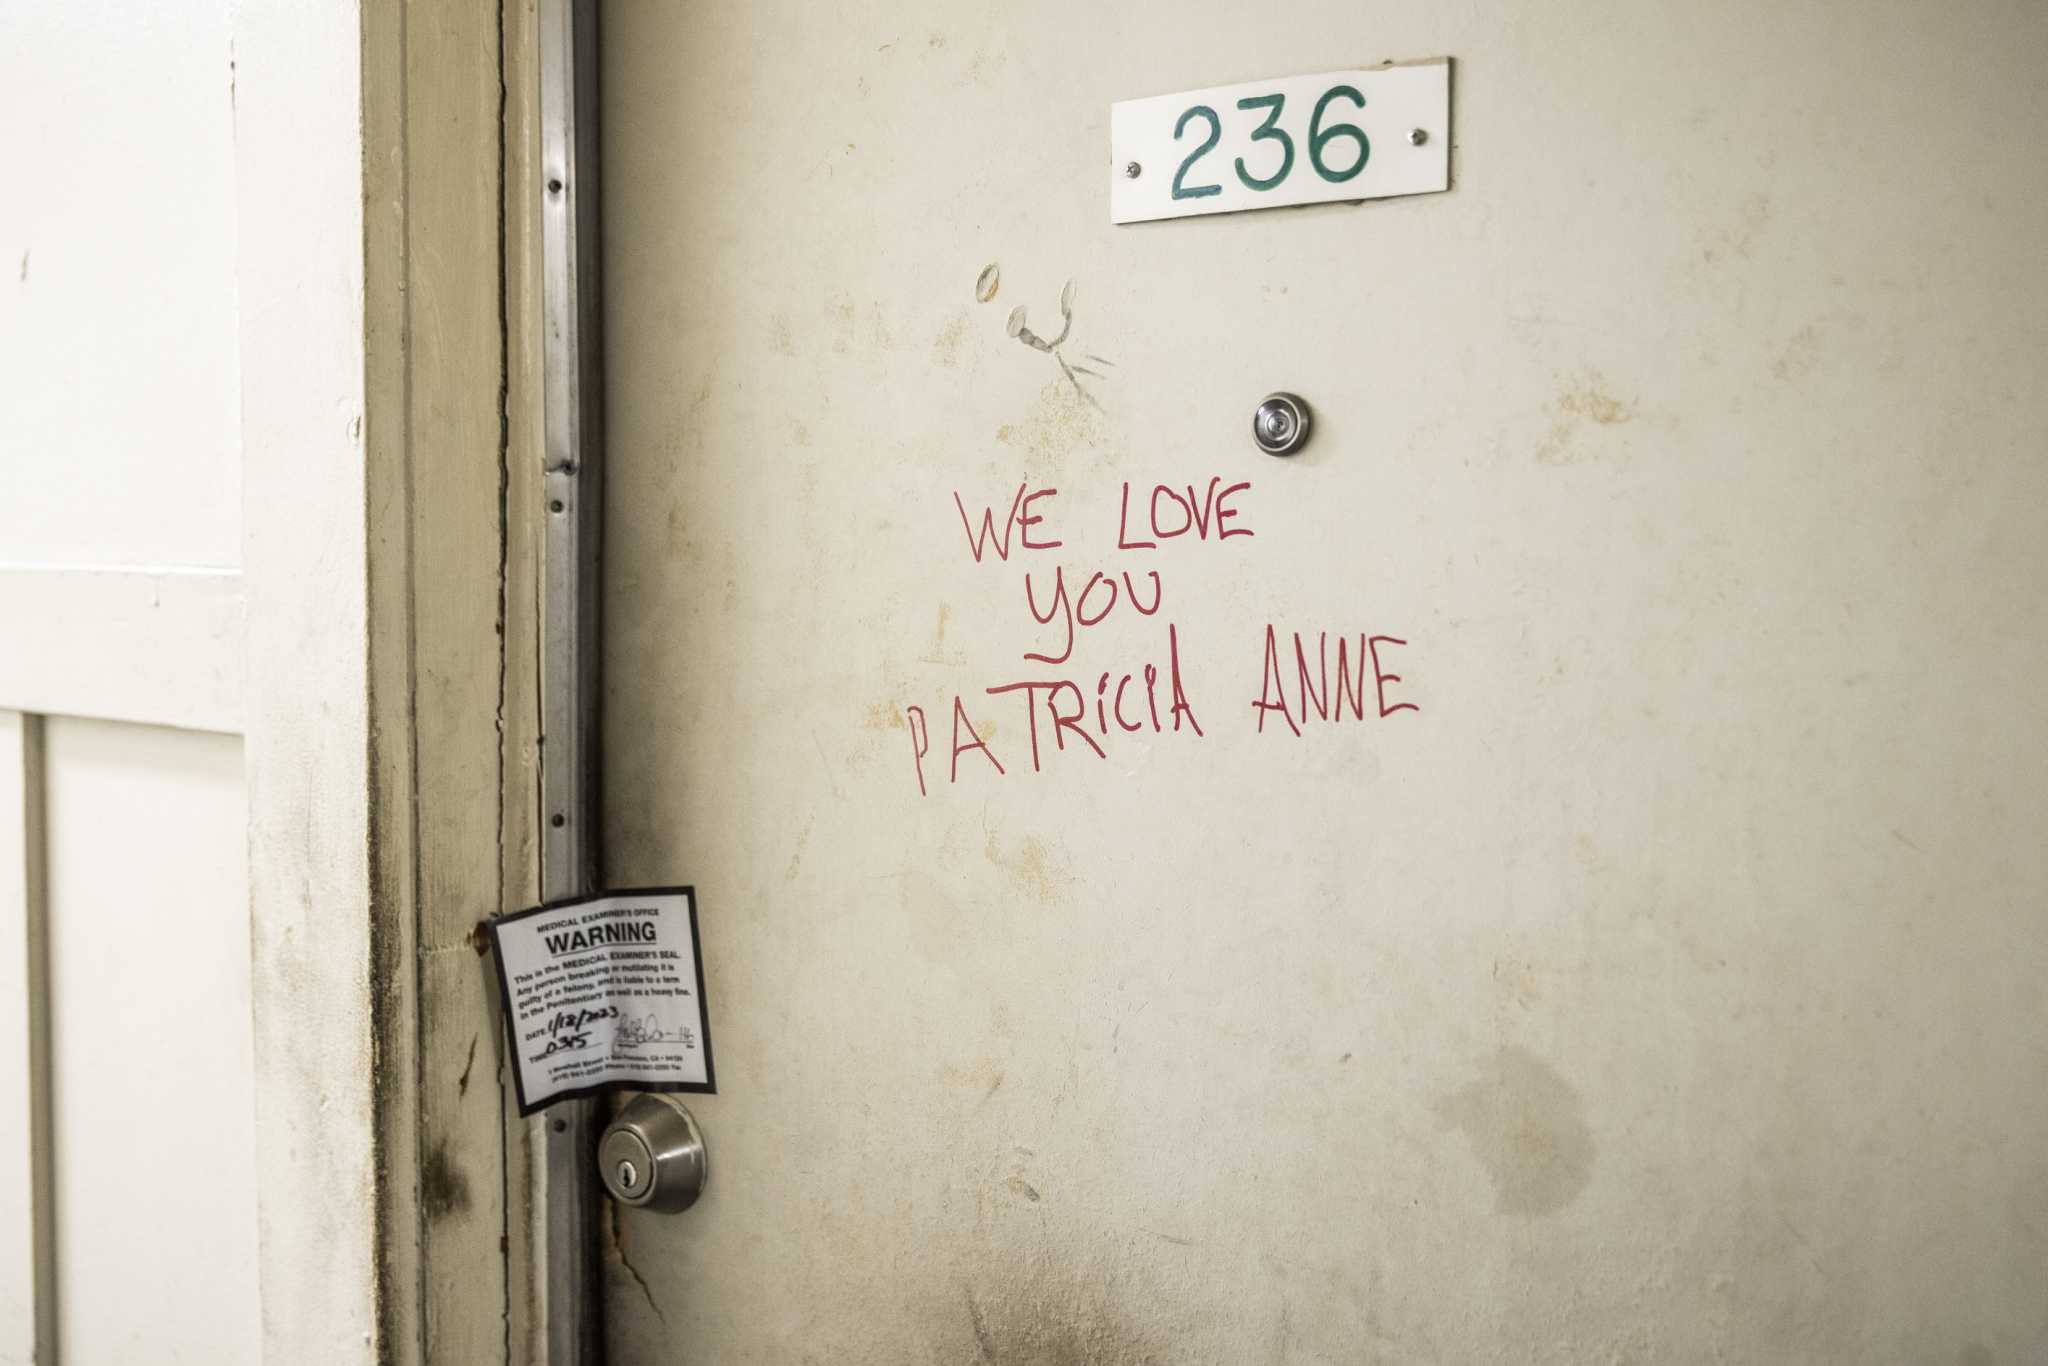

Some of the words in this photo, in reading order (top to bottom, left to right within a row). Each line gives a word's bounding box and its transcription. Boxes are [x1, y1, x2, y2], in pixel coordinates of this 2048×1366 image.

[1171, 85, 1371, 200] 236
[954, 483, 1063, 563] WE
[1118, 477, 1254, 551] LOVE
[1251, 623, 1420, 738] ANNE
[537, 918, 578, 933] MEDICAL
[581, 909, 632, 923] EXAMINER'S
[633, 908, 659, 916] OFFICE
[544, 921, 656, 954] WARNING
[514, 974, 533, 984] This
[534, 970, 543, 978] is
[544, 965, 560, 974] the
[562, 954, 606, 969] MEDICAL
[610, 951, 657, 960] EXAMINER'S
[517, 986, 532, 997] Any
[534, 976, 566, 991] person
[567, 966, 610, 981] breaking
[530, 1007, 544, 1016] the
